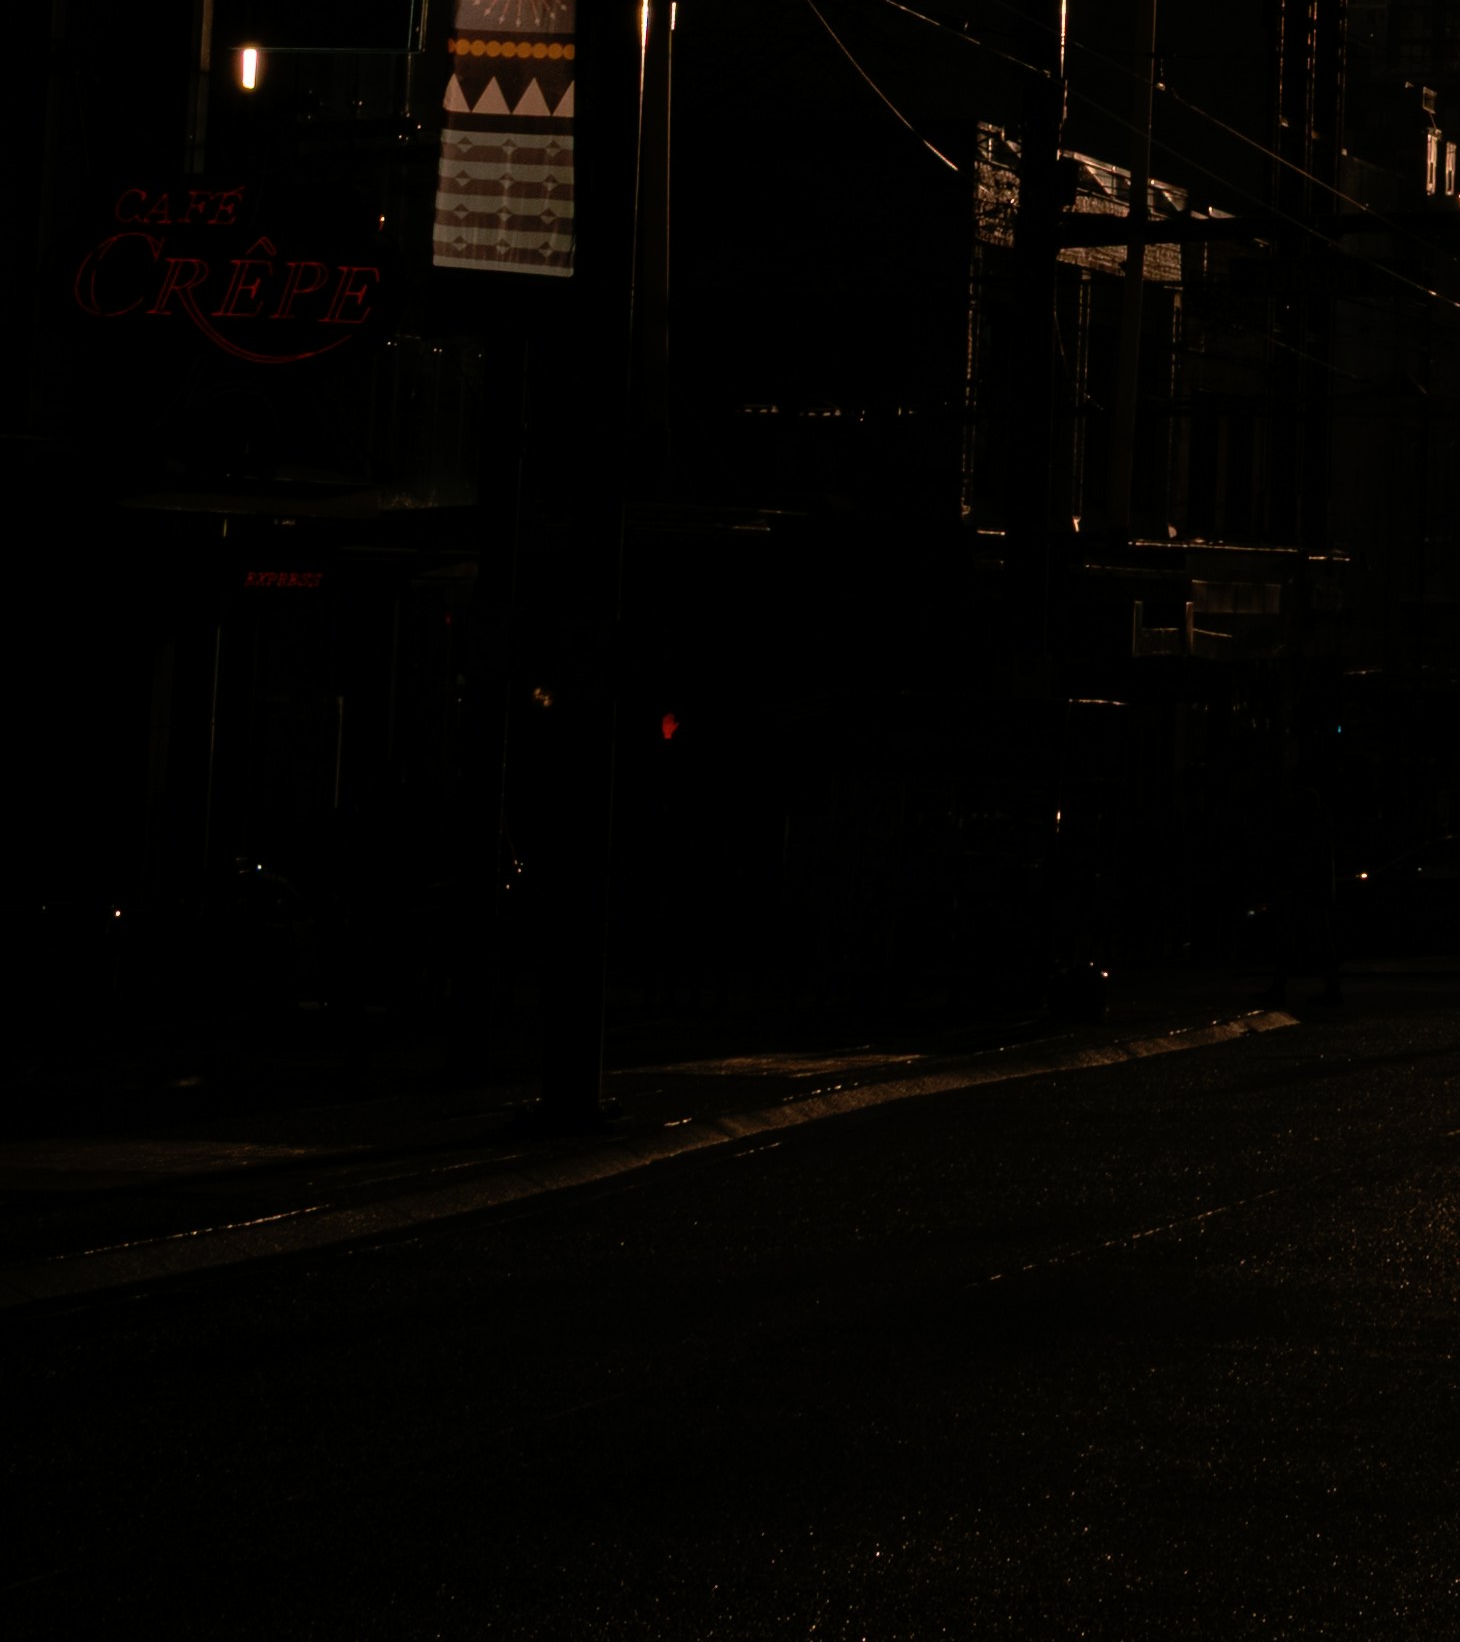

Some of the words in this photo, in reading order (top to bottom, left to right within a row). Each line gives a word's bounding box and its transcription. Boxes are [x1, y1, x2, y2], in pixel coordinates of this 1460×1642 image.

[115, 183, 248, 225] CAFÉ
[1254, 266, 1358, 290] Robson
[73, 231, 382, 364] CRÊPE
[243, 570, 324, 589] EXPRESS
